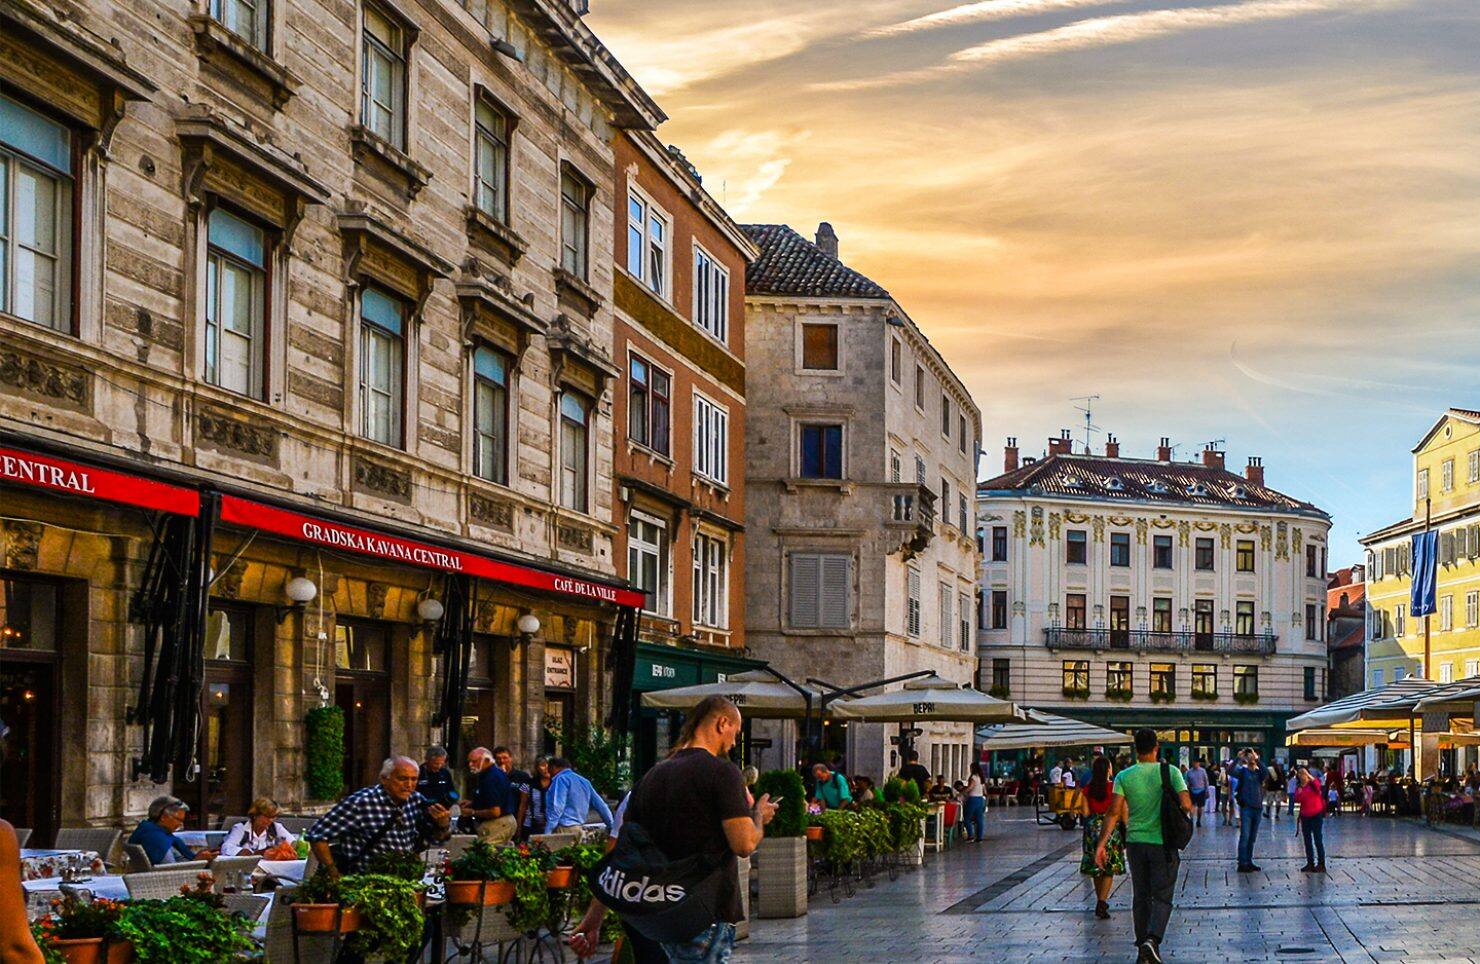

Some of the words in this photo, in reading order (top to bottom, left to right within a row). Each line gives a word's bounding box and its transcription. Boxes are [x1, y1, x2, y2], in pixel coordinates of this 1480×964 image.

[0, 455, 95, 493] ENTRAL
[302, 522, 365, 550] GRADSKA
[367, 537, 412, 560] KAVANA
[413, 548, 463, 570] CENTRAL
[575, 582, 586, 594] DE
[587, 585, 597, 597] LA
[597, 587, 617, 601] VILLE
[599, 866, 687, 903] adidas
